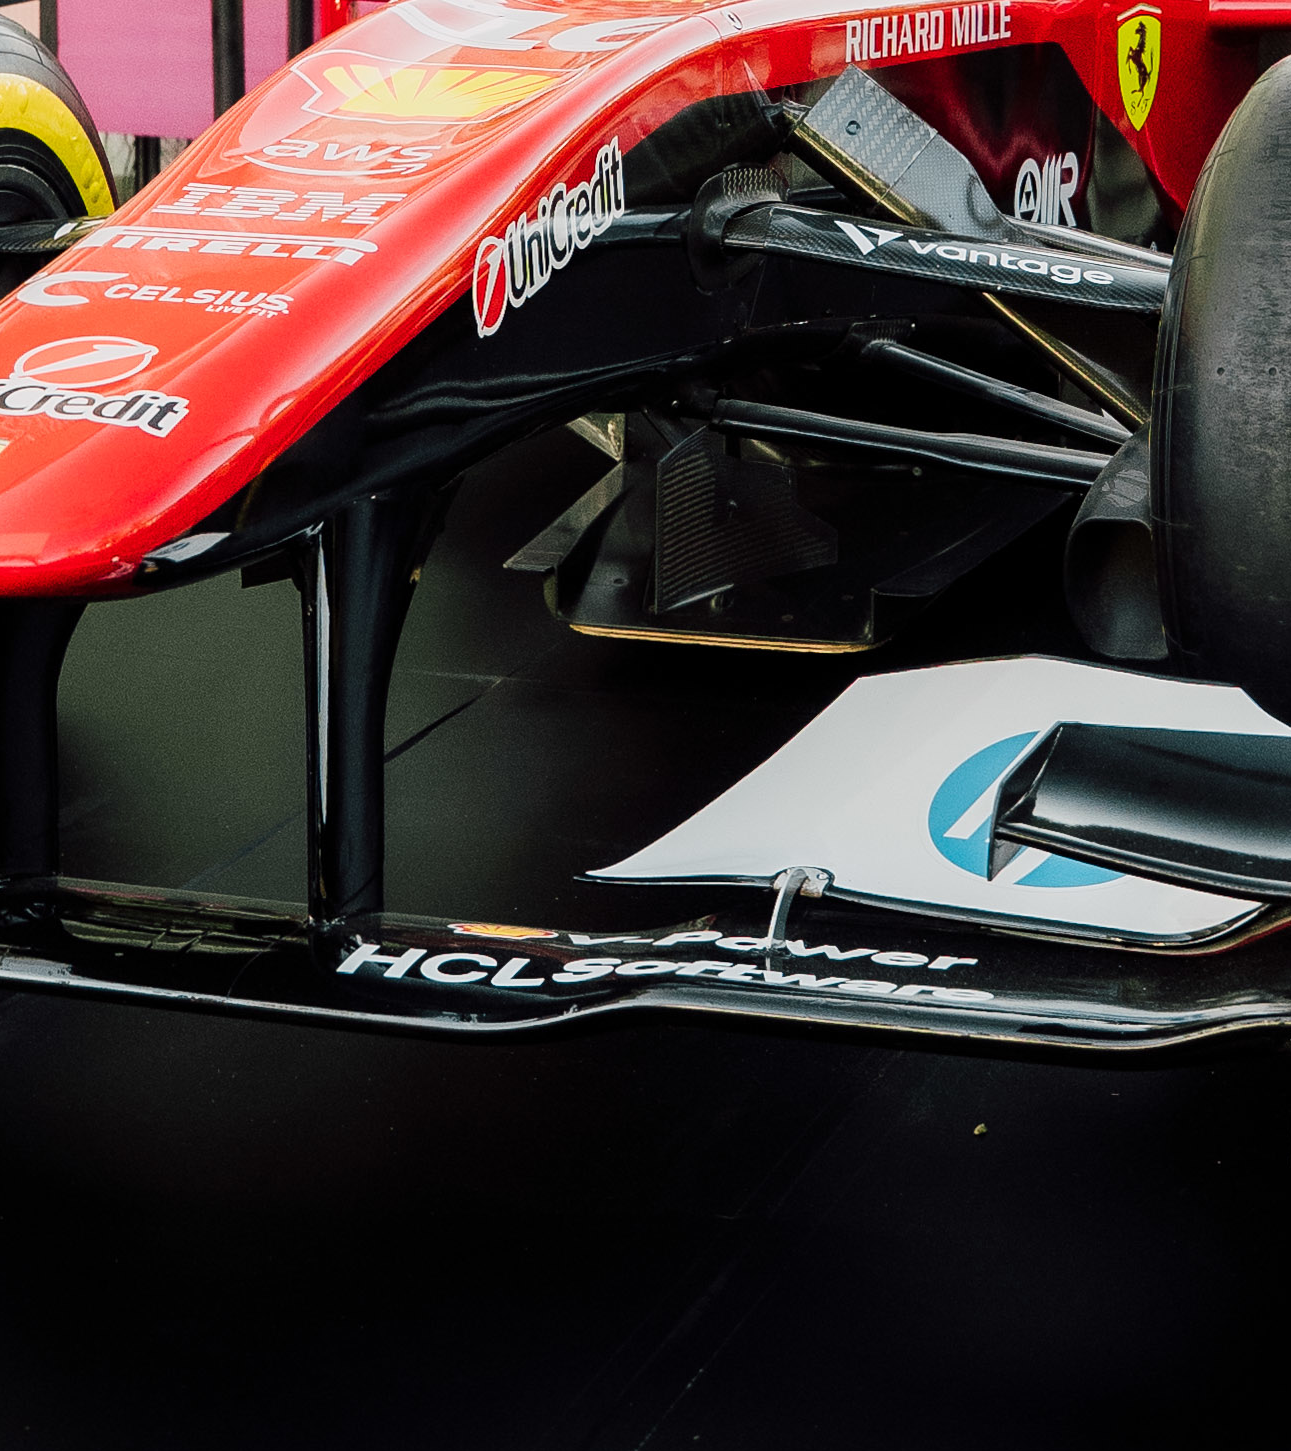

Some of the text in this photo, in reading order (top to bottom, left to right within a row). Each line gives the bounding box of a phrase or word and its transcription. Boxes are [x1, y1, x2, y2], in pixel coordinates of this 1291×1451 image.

[845, 0, 1012, 64] RICHARD MILLE
[262, 138, 443, 166] aws
[150, 181, 409, 226] IBM
[509, 137, 625, 307] UniCredit
[72, 224, 378, 266] PIRELLI
[911, 242, 1114, 286] vantage
[104, 282, 295, 311] CELSIUS
[204, 304, 279, 318] LIVE FIT
